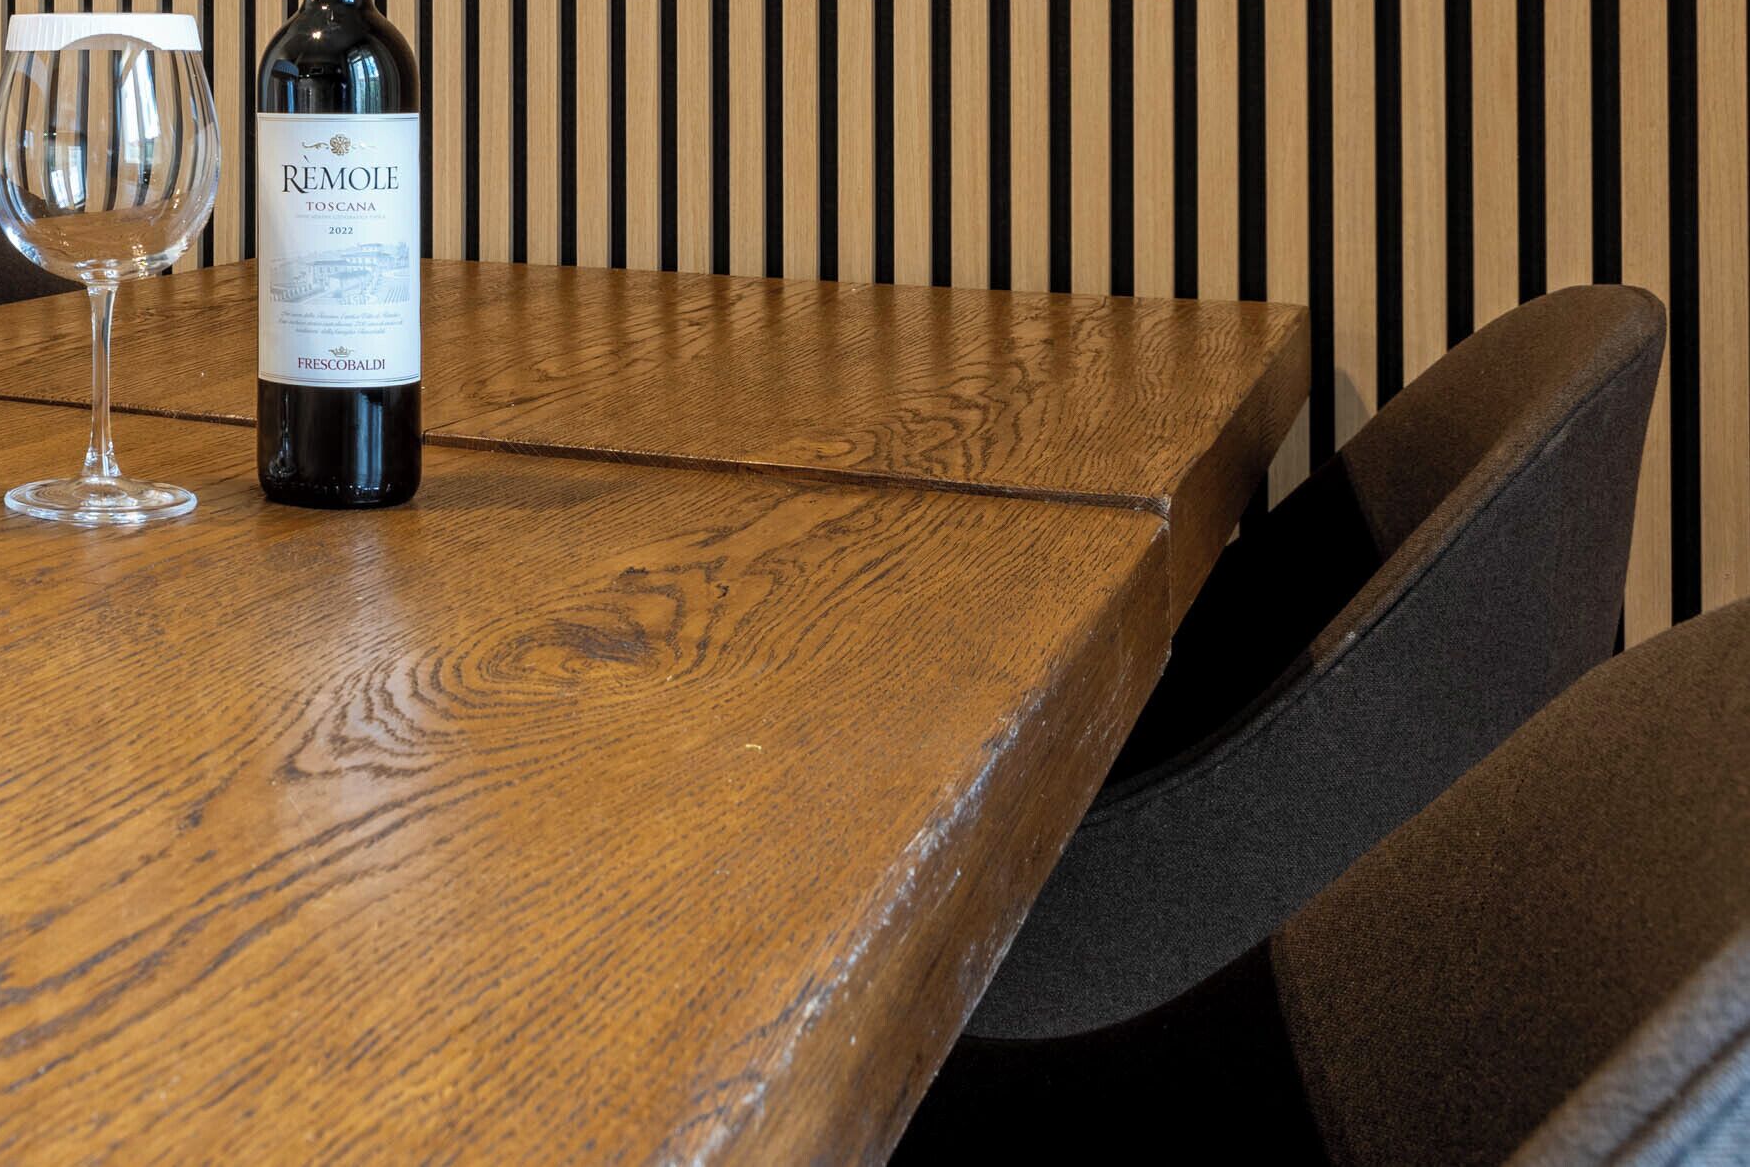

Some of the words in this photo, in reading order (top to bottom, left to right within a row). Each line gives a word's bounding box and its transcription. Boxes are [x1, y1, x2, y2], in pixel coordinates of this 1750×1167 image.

[282, 156, 400, 194] RÈMOLE
[306, 201, 376, 211] TOSCANA
[329, 226, 354, 235] 2022
[297, 357, 386, 371] FRESCOBALDI
